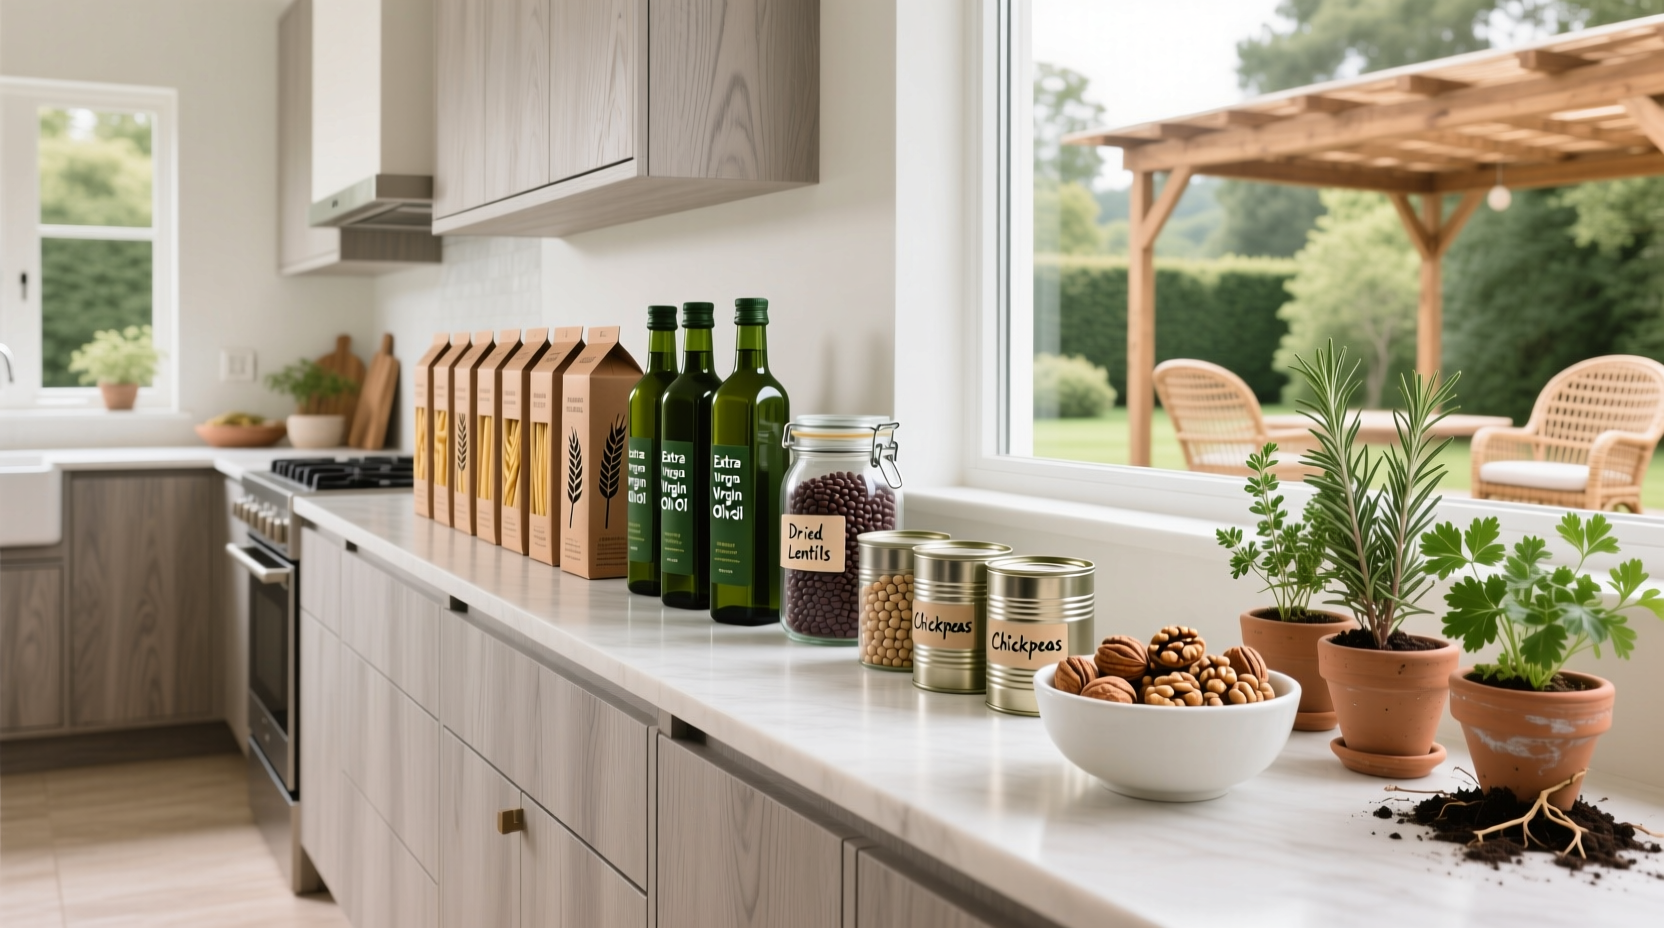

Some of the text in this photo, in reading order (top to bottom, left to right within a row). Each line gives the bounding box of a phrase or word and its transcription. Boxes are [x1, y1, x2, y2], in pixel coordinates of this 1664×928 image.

[713, 454, 741, 468] Extra
[788, 522, 824, 541] Dried
[788, 545, 831, 562] Lentils
[913, 611, 972, 640] Chickpeas
[991, 632, 1063, 660] Chickpeas
